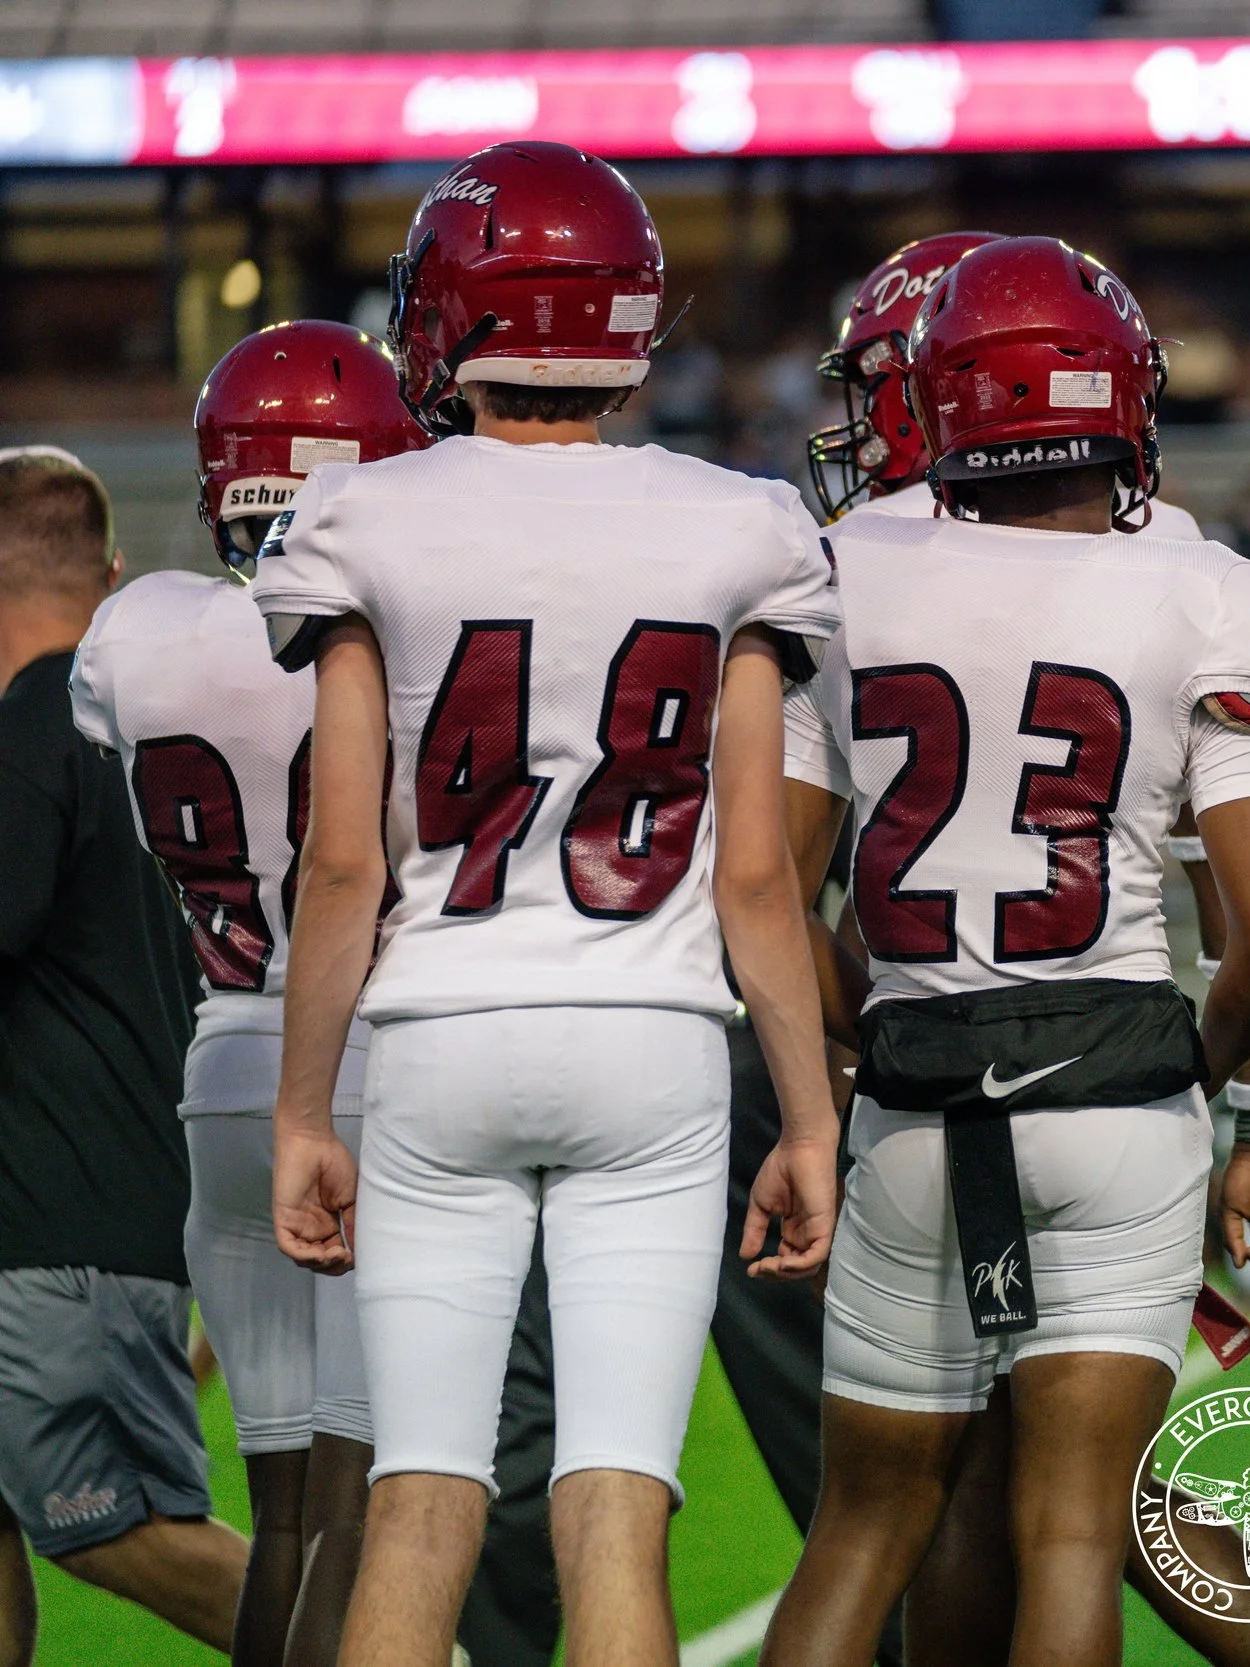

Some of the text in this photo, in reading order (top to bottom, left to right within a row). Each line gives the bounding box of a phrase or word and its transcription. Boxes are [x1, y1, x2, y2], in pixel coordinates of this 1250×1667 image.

[966, 438, 1090, 469] Riddell
[417, 619, 720, 921] 48
[850, 661, 1131, 964] 23
[981, 1311, 1027, 1325] WE BALL.
